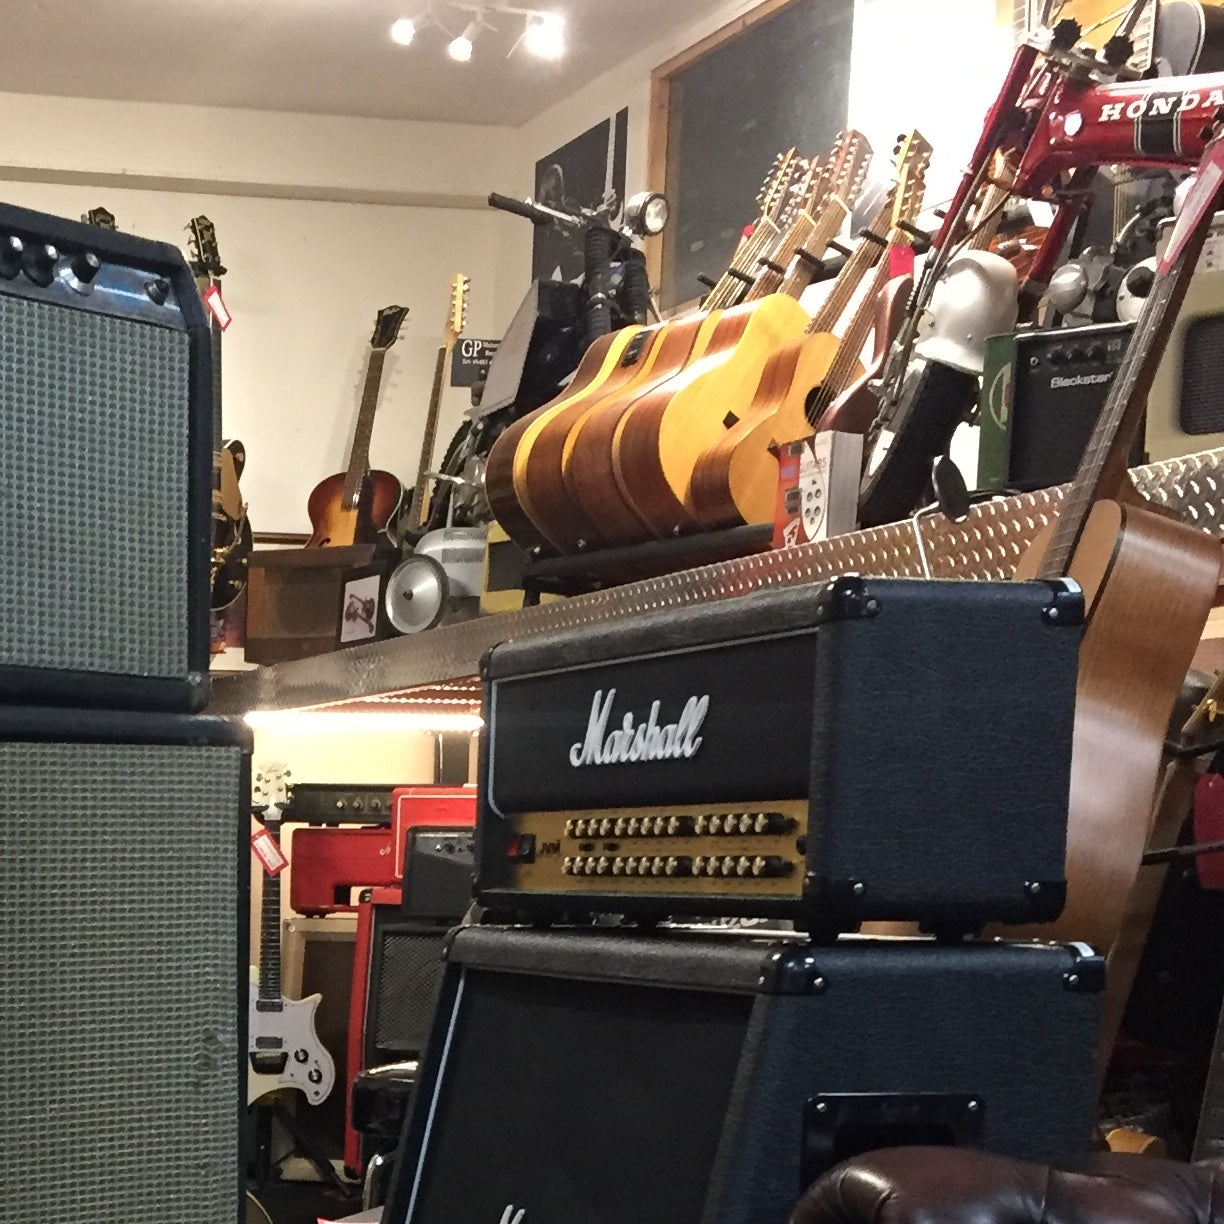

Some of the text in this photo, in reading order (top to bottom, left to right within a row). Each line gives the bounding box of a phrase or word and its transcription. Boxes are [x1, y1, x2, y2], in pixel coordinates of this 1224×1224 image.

[1098, 89, 1224, 122] HONDA
[462, 340, 482, 357] GP
[1050, 372, 1112, 389] Blackstar
[569, 688, 710, 768] Marshall
